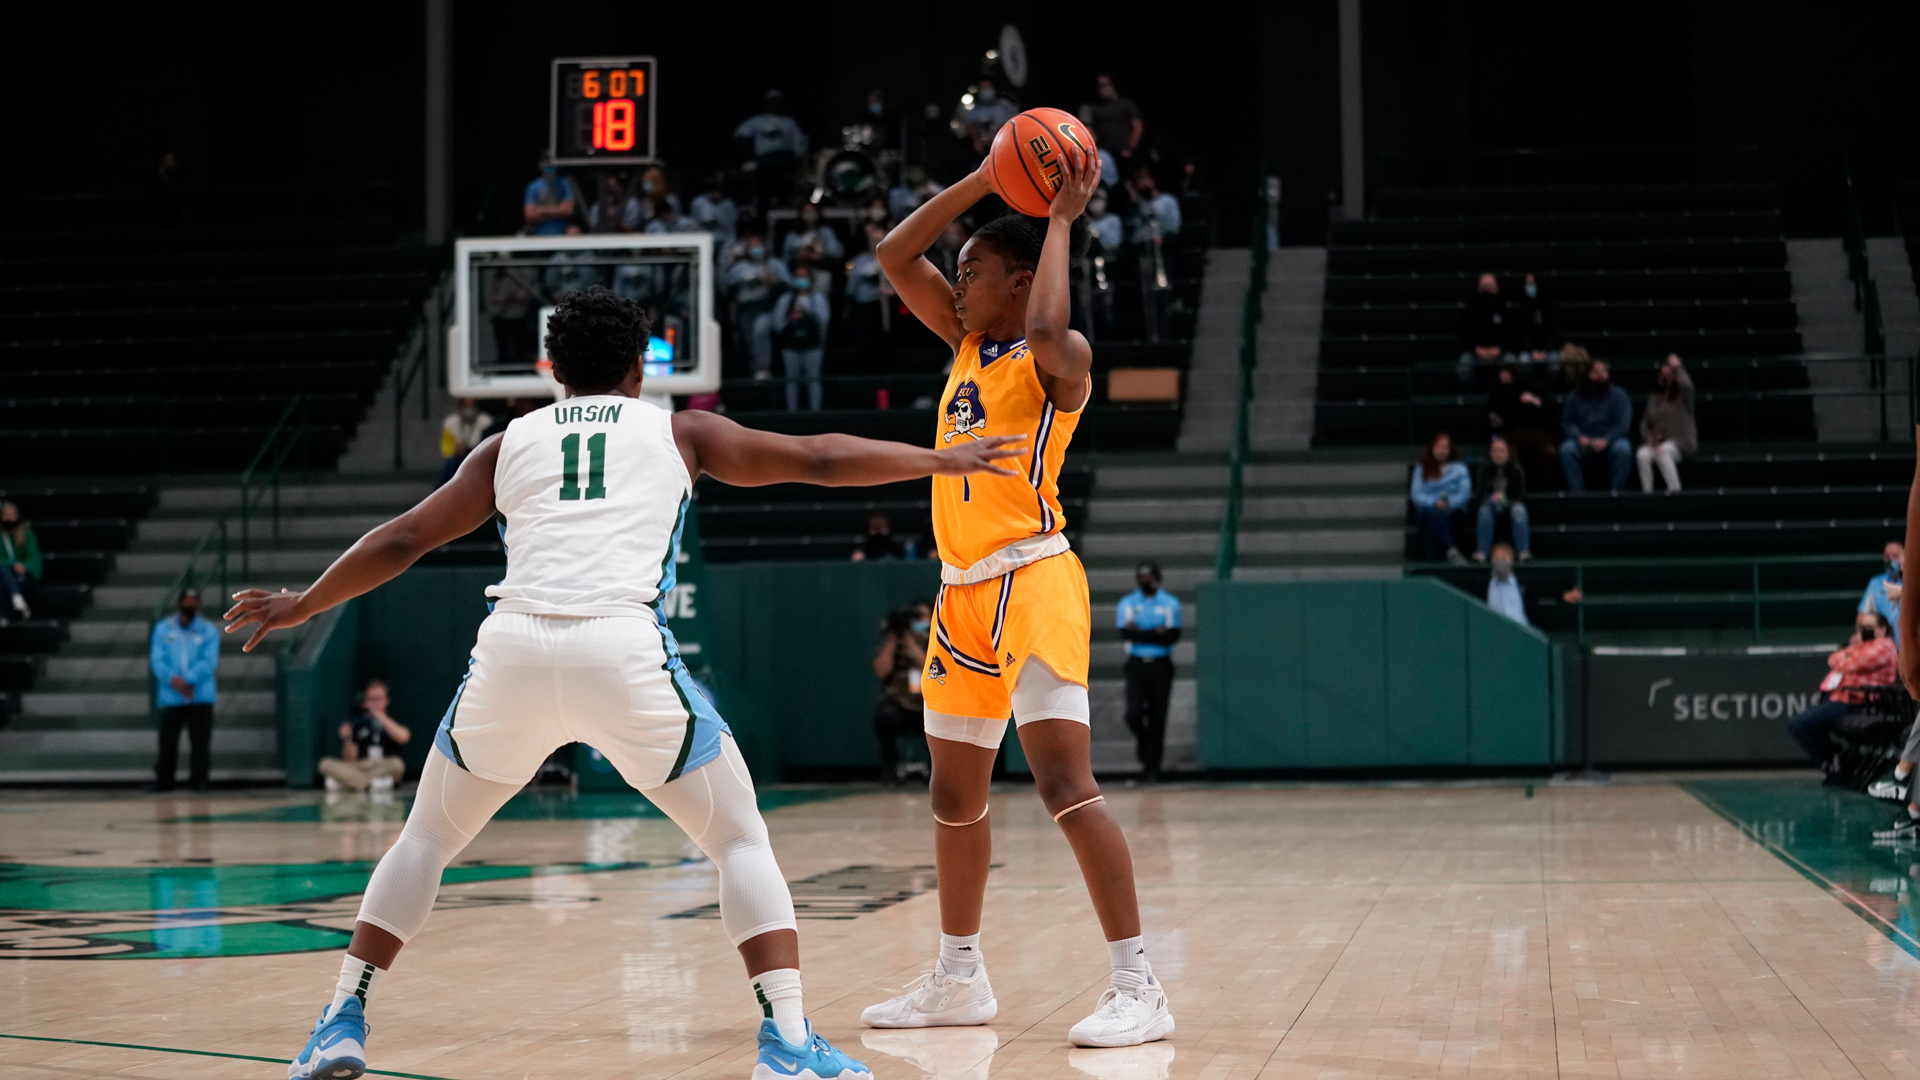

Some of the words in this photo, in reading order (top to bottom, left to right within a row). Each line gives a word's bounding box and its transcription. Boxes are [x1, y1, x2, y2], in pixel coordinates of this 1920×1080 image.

[593, 99, 635, 151] 18
[1023, 142, 1055, 193] CHAMPIONSHI
[1029, 135, 1064, 193] ELITE
[554, 403, 624, 425] URSIN
[957, 387, 974, 397] ECU
[559, 432, 607, 501] 11
